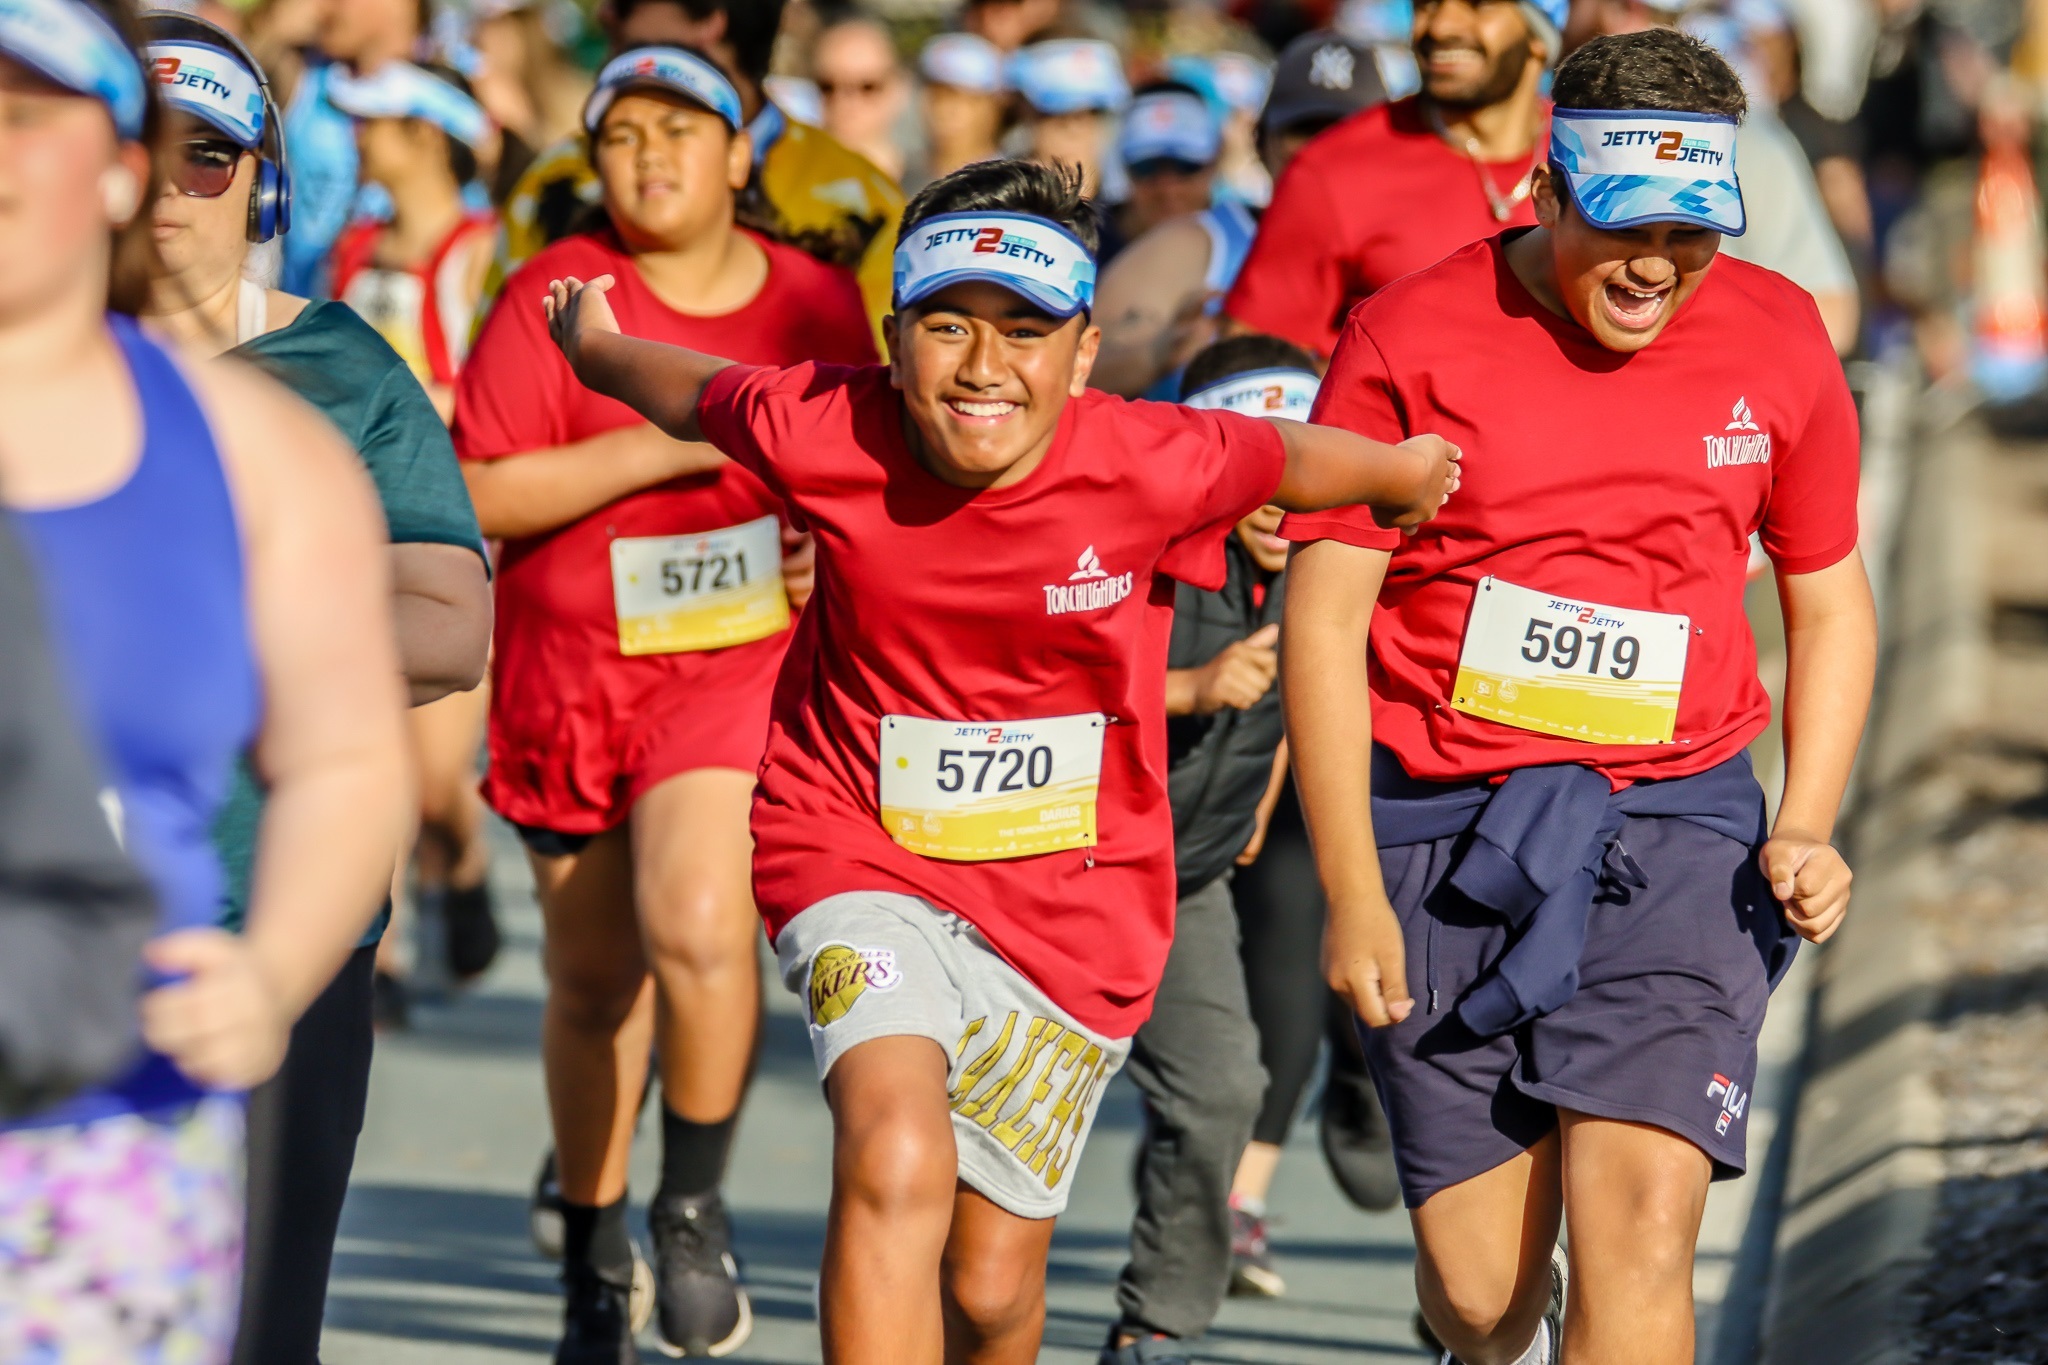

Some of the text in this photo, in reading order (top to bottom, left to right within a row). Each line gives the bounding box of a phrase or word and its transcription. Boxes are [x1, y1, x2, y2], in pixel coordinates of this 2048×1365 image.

[150, 57, 181, 85] 2
[174, 73, 231, 99] JETTY
[1602, 131, 1724, 166] JETTY 2 JETTY
[924, 227, 1055, 268] JETTY 2 JETTY
[1263, 385, 1283, 411] 2
[661, 550, 748, 596] 5721
[1043, 571, 1133, 615] TORCHLIGHTERS
[1547, 600, 1625, 629] JETTY 2 JETTY
[1521, 617, 1640, 680] 5919
[954, 727, 1034, 744] JETTY 2 JETTY
[936, 745, 1053, 793] 5720
[1040, 804, 1081, 823] DARIUS
[1706, 1072, 1747, 1119] FILA
